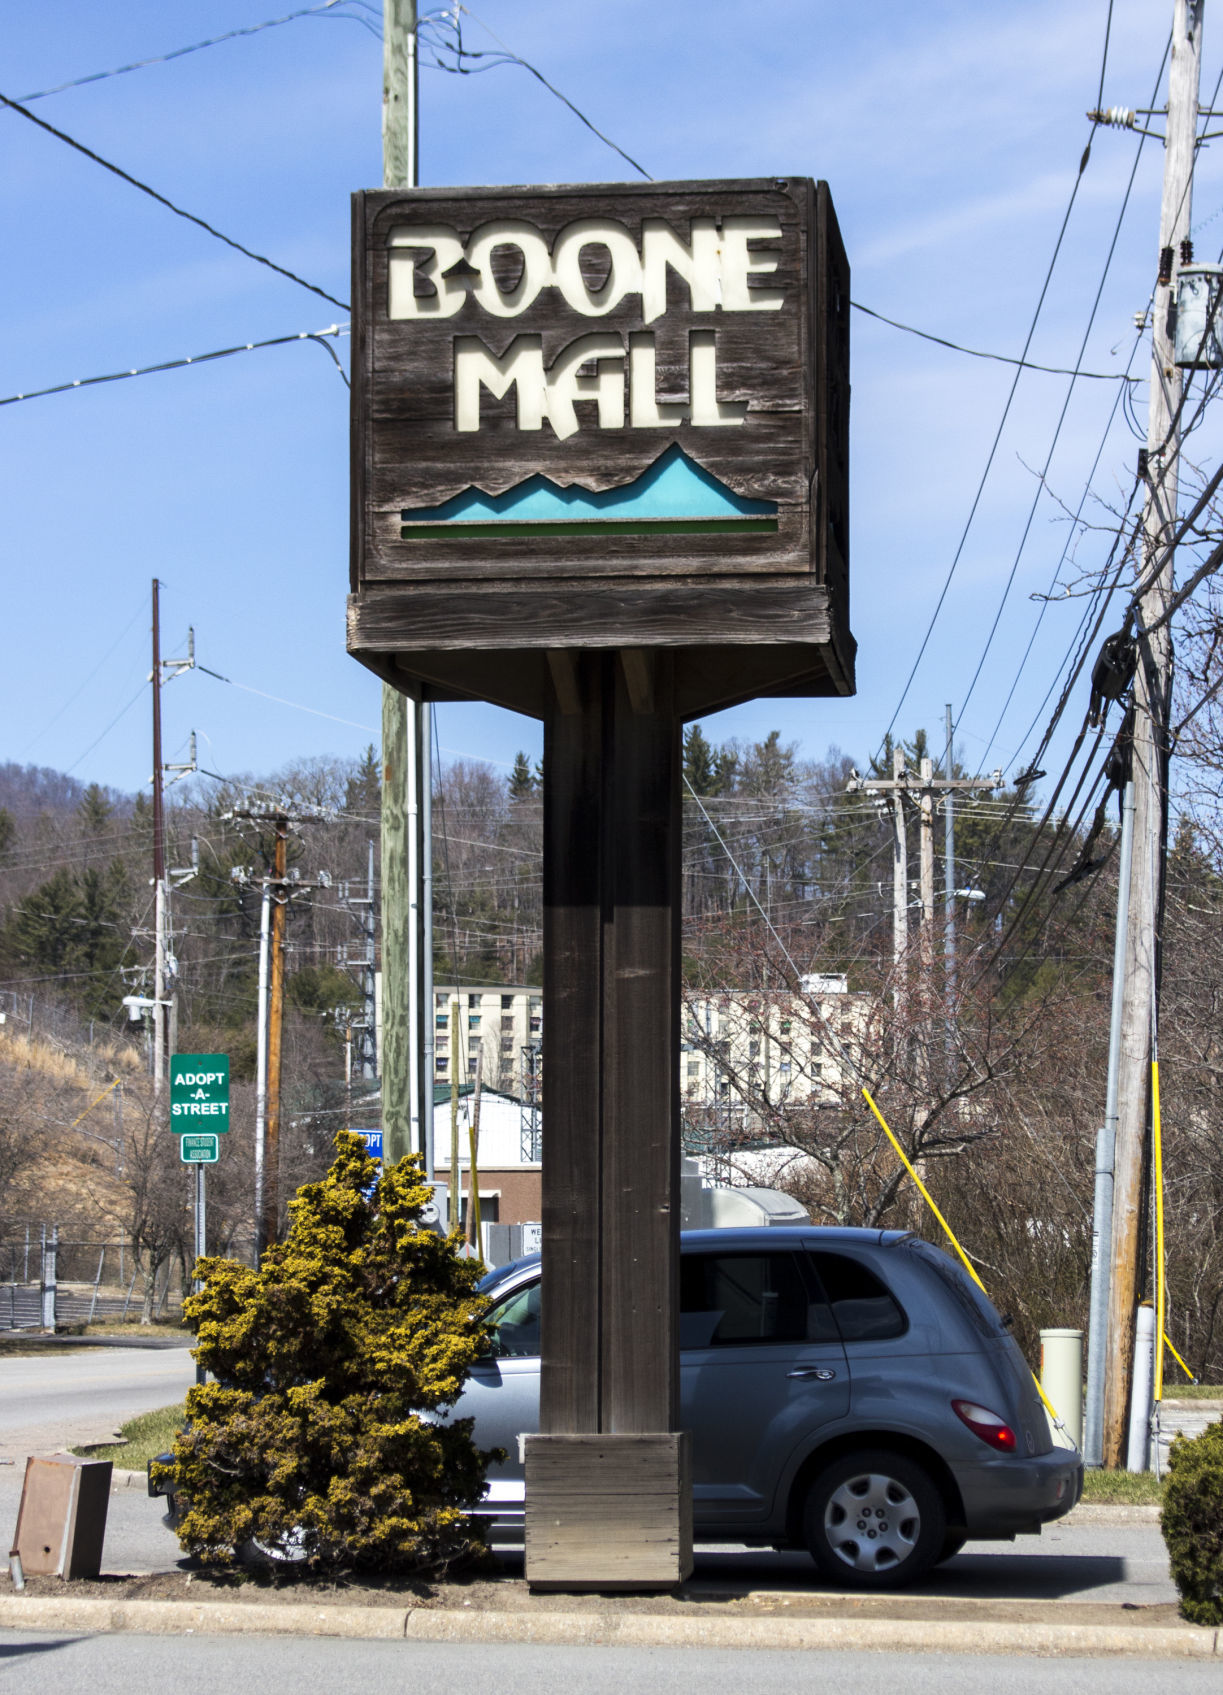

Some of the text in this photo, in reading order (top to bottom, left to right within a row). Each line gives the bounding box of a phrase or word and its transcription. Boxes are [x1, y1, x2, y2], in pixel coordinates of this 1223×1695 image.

[388, 215, 785, 324] BOONE
[453, 329, 749, 440] MALL
[174, 1073, 225, 1085] ADOPT
[190, 1088, 210, 1100] -A-
[172, 1103, 228, 1115] STREET
